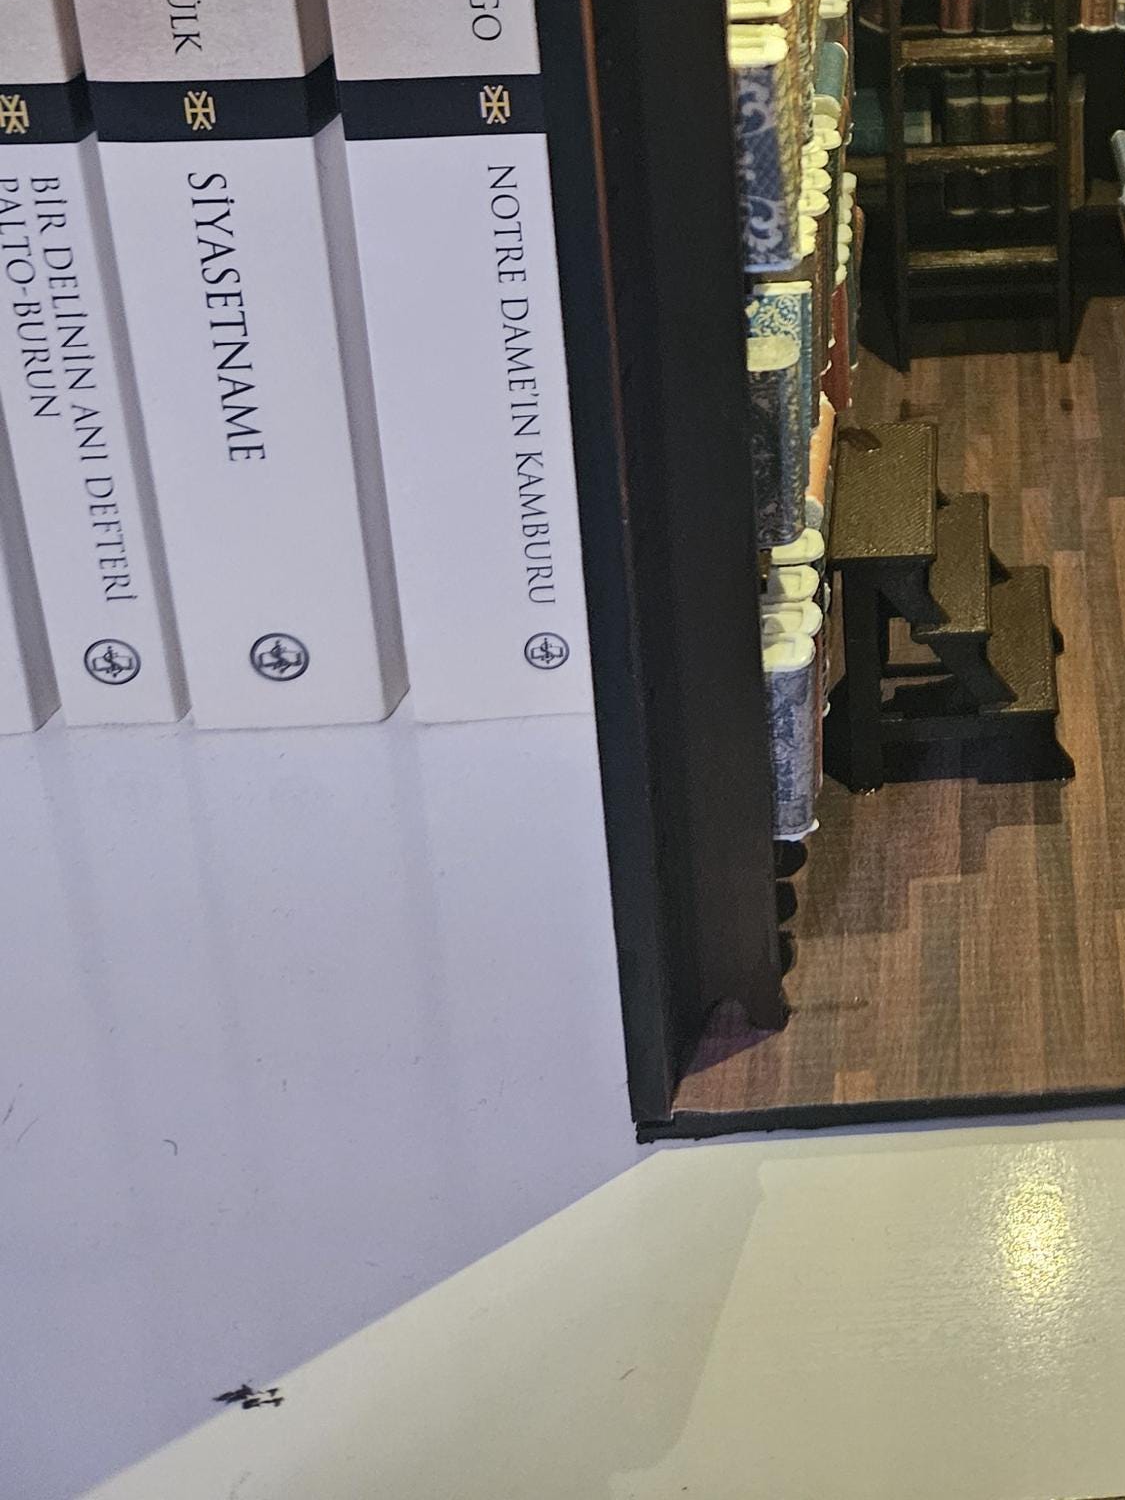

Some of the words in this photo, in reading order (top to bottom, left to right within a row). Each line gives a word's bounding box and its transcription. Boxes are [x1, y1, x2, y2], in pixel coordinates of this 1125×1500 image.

[30, 177, 68, 233] BİR
[42, 247, 96, 390] DELİNİN
[187, 172, 266, 460] SİYASETNAME
[71, 404, 108, 461] ANI
[487, 166, 527, 284] NOTRE
[515, 451, 556, 604] KAMBURU
[84, 476, 138, 602] DEFTERİ
